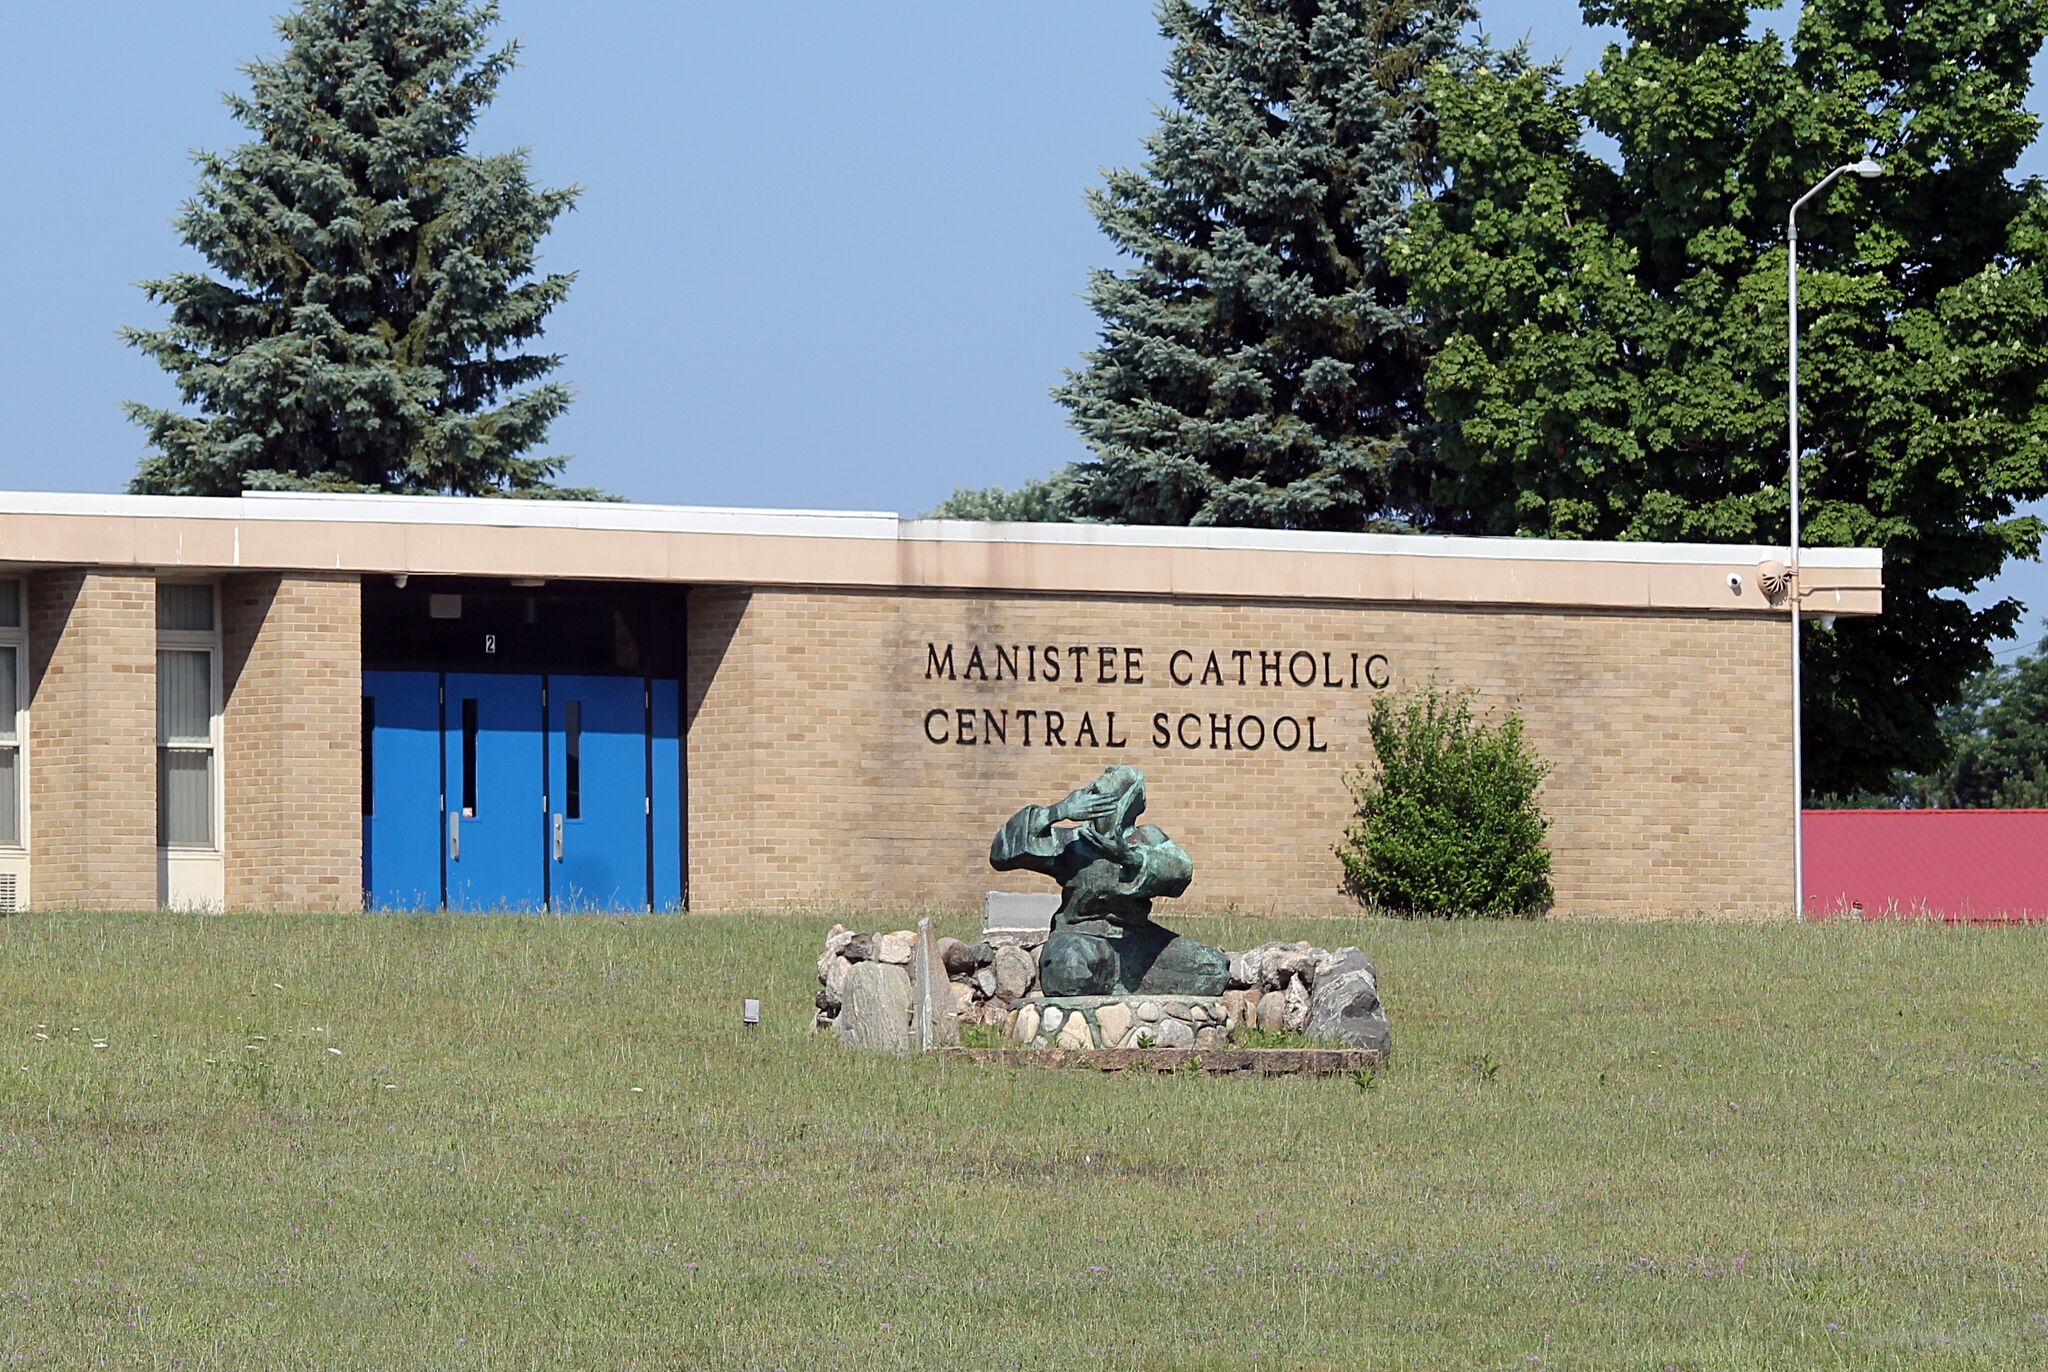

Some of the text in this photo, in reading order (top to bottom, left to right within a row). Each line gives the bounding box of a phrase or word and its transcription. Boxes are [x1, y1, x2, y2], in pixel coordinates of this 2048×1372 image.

[487, 635, 495, 652] 2
[925, 643, 1390, 689] MANISTEE CATHOLIC
[924, 708, 1328, 752] CENTRAL SCHOOL
